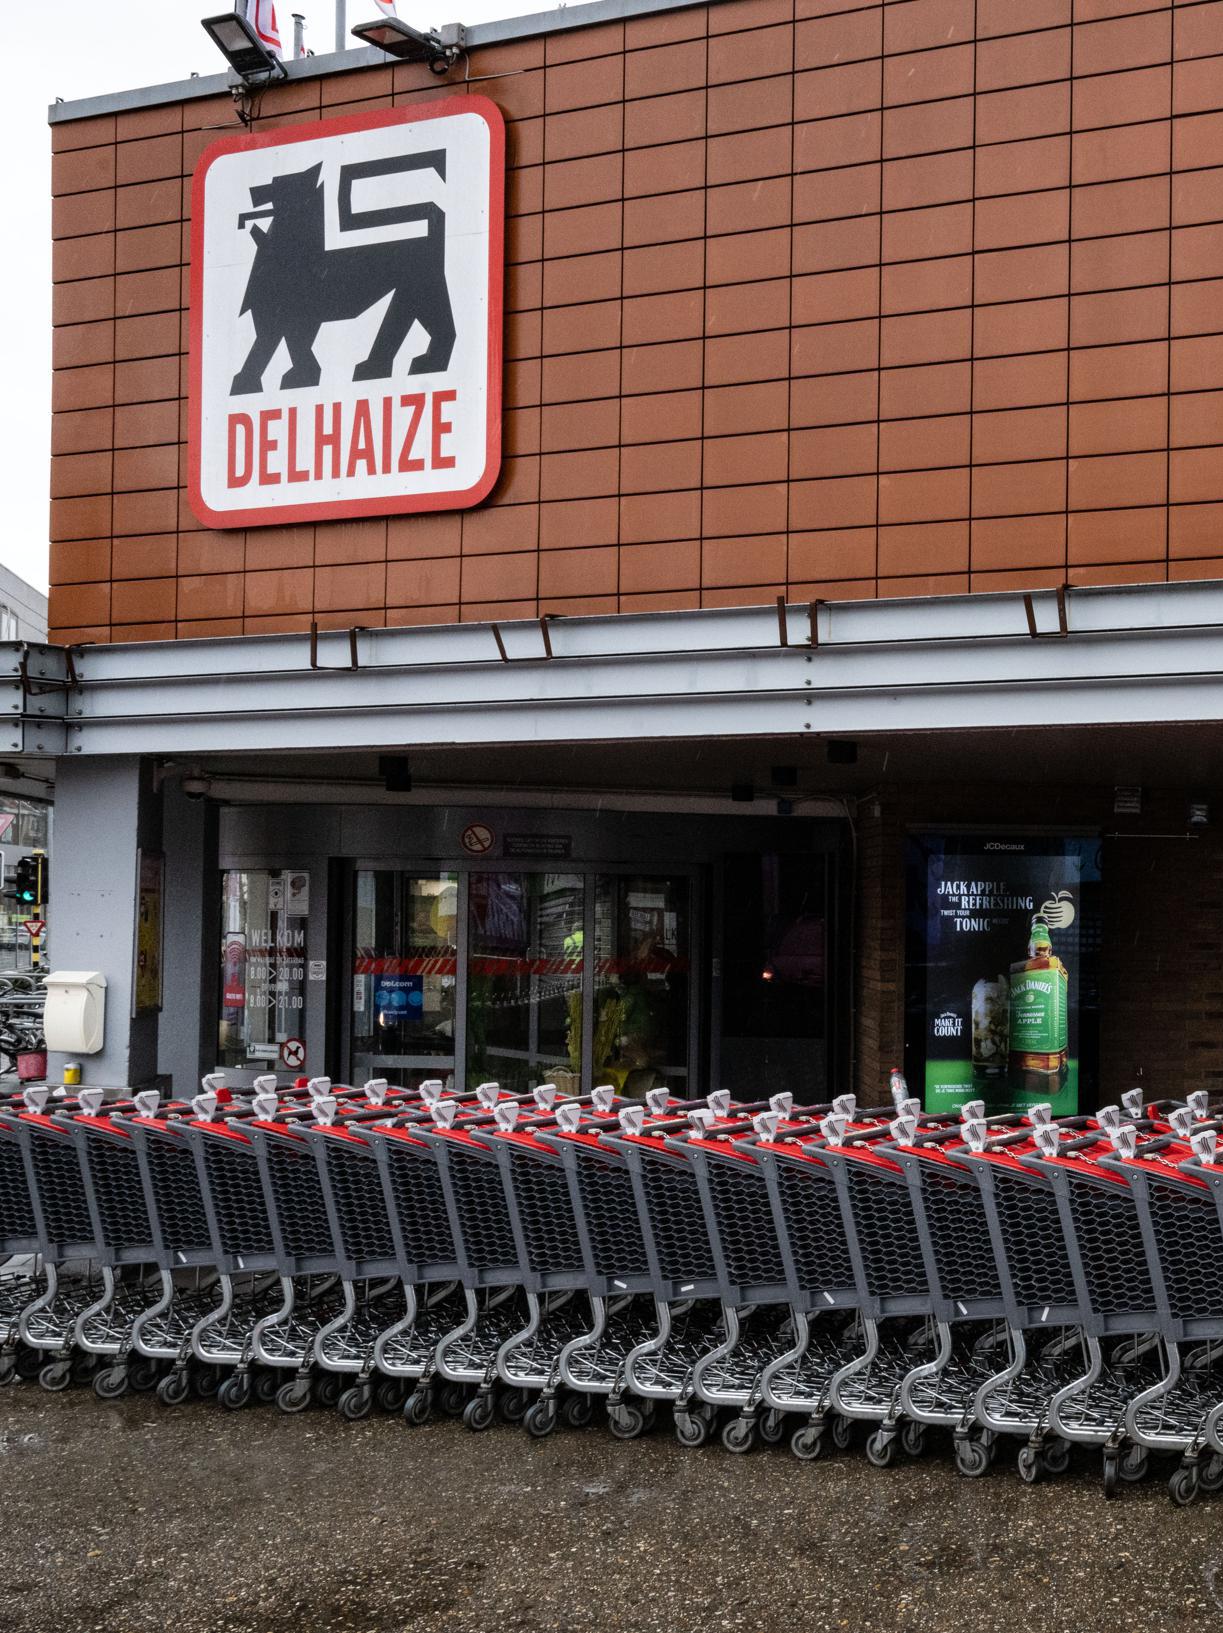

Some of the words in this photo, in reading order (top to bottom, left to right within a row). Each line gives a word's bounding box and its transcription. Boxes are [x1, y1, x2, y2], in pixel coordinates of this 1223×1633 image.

[227, 389, 457, 489] DELHAIZE
[937, 881, 968, 895] JACK
[961, 896, 1034, 909] REFRESHING
[954, 918, 991, 931] TONIC
[251, 929, 304, 947] WELKOM
[250, 967, 267, 979] 8.00
[279, 967, 304, 980] 20.00
[1010, 984, 1026, 997] JACK
[250, 994, 266, 1007] 8.00
[279, 996, 303, 1008] 21.00
[934, 1018, 954, 1027] MAKE
[955, 1018, 963, 1027] IT
[934, 1026, 962, 1036] COUNT
